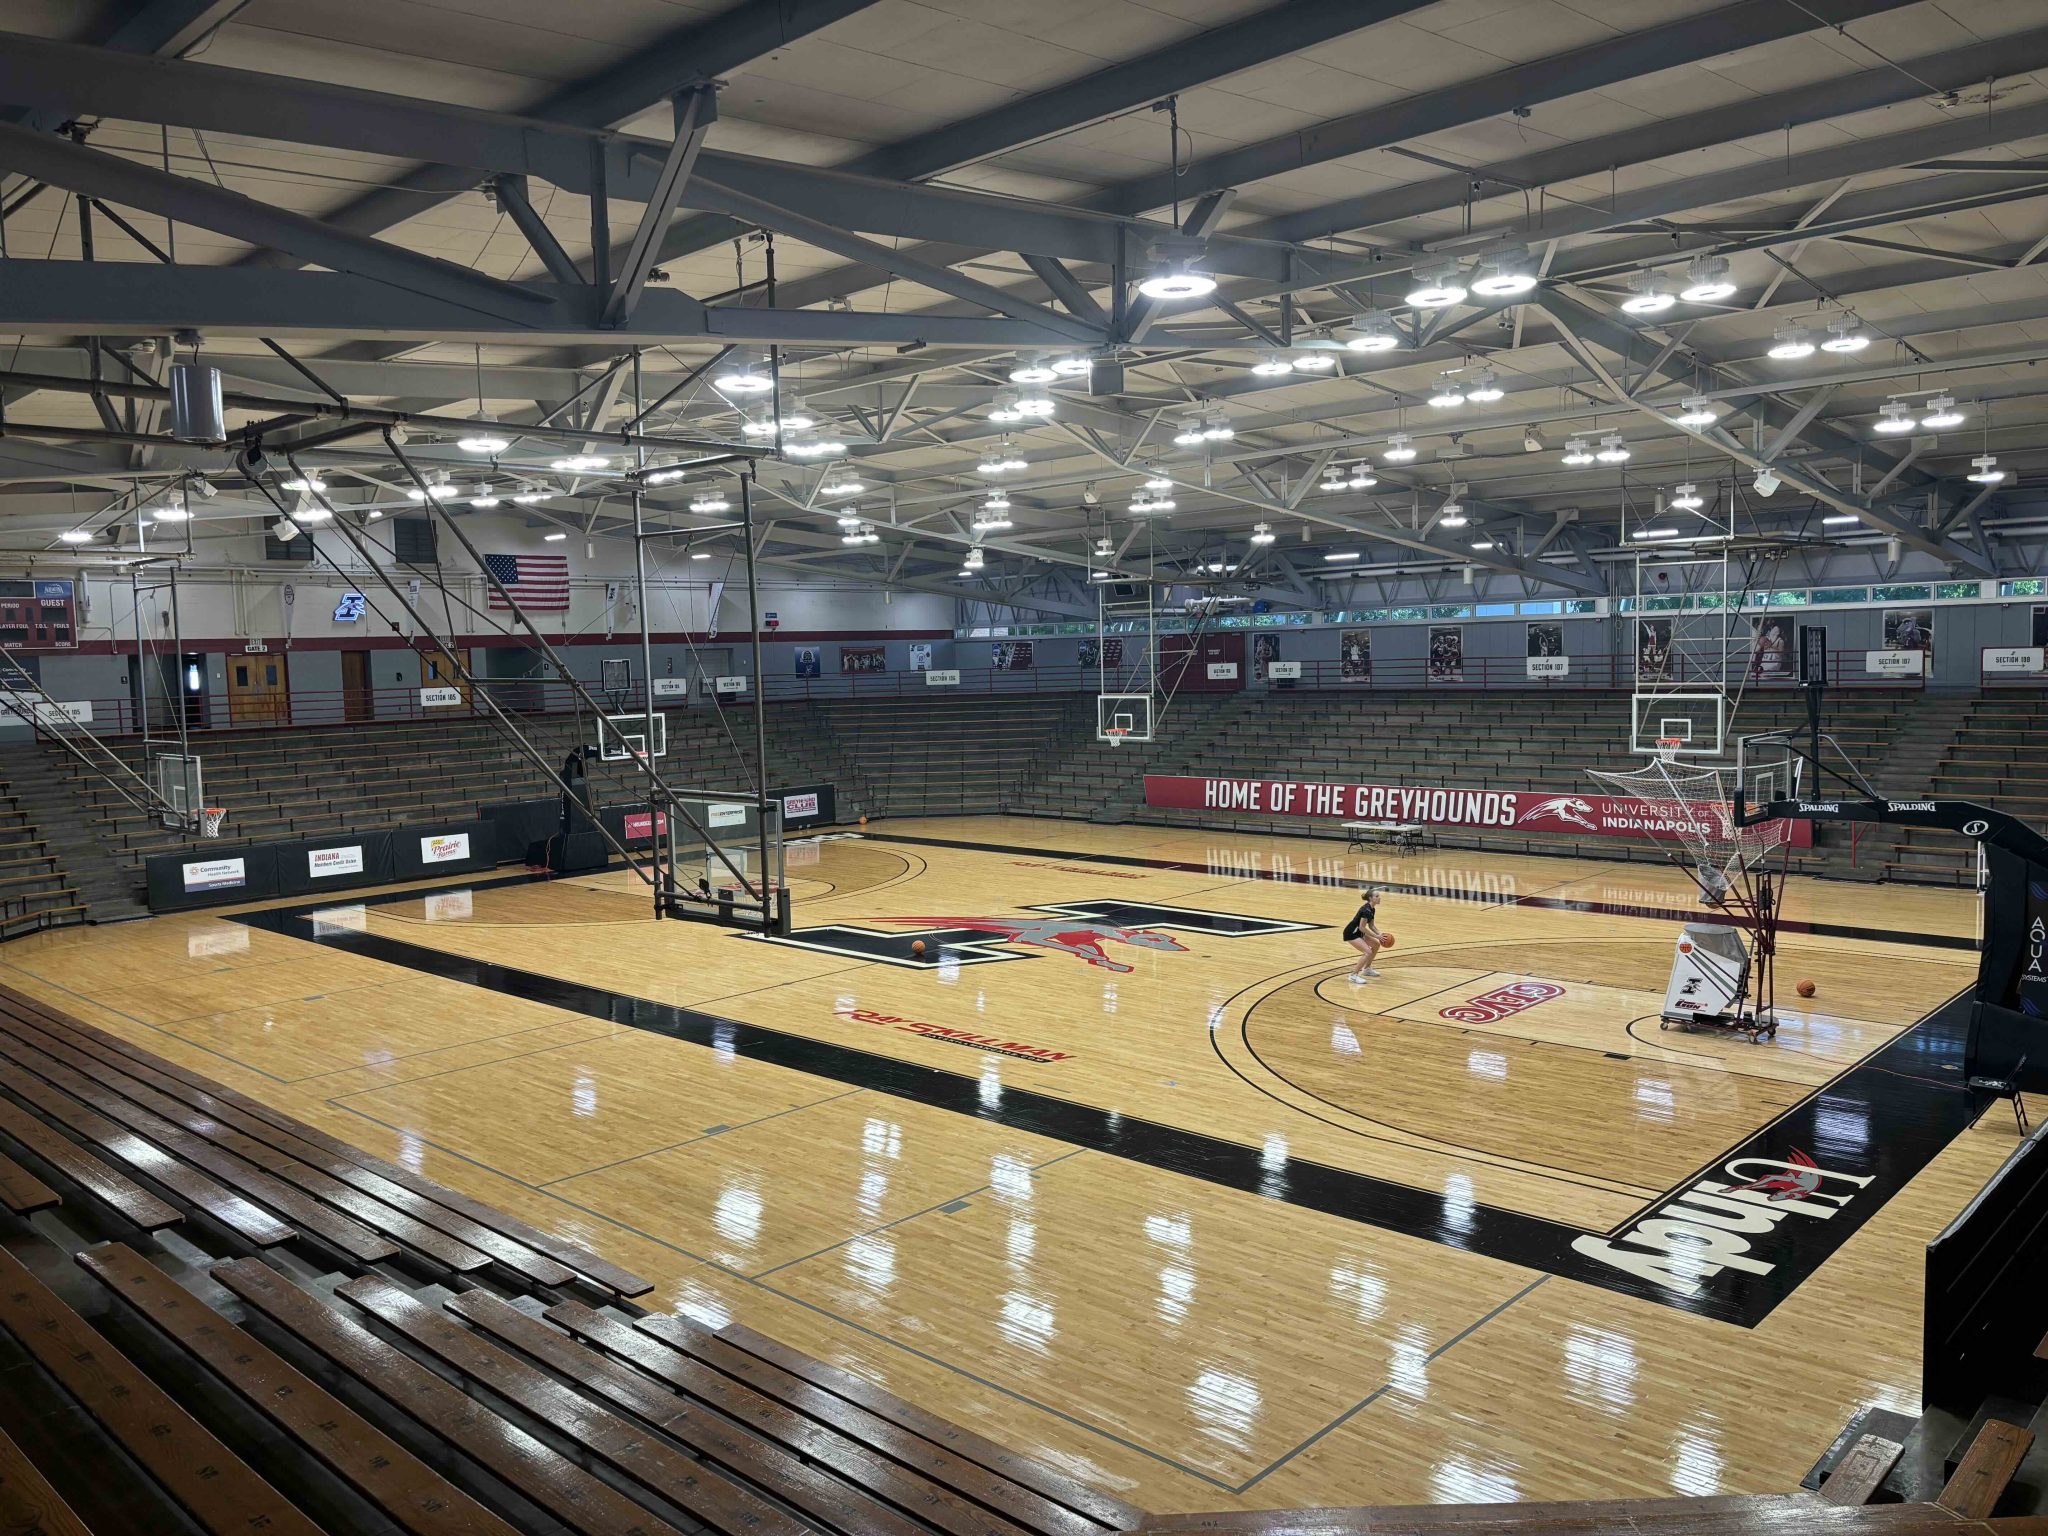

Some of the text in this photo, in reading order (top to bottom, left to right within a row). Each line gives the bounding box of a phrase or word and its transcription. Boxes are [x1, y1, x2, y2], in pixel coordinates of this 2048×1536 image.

[41, 599, 65, 607] GUEST
[1532, 663, 1563, 671] SECTION 107
[425, 694, 446, 702] SECTION
[1205, 780, 1517, 826] HOME OF THE GREYHOUNDS
[1799, 803, 1839, 813] SPALDING
[1888, 802, 1937, 812] SPALDING
[1602, 803, 1709, 818] UNIVERSITY OF
[1602, 816, 1712, 834] INDIANAPOLIS
[432, 841, 461, 854] Prairie
[314, 852, 340, 862] INDIANA
[200, 865, 231, 873] Community
[2028, 915, 2046, 973] AQUA
[2021, 973, 2047, 983] SYSTEMS
[1438, 982, 1567, 1024] GLVC
[833, 1009, 1078, 1062] RAY SKILLMAN
[1571, 1157, 1877, 1296] UIndy
